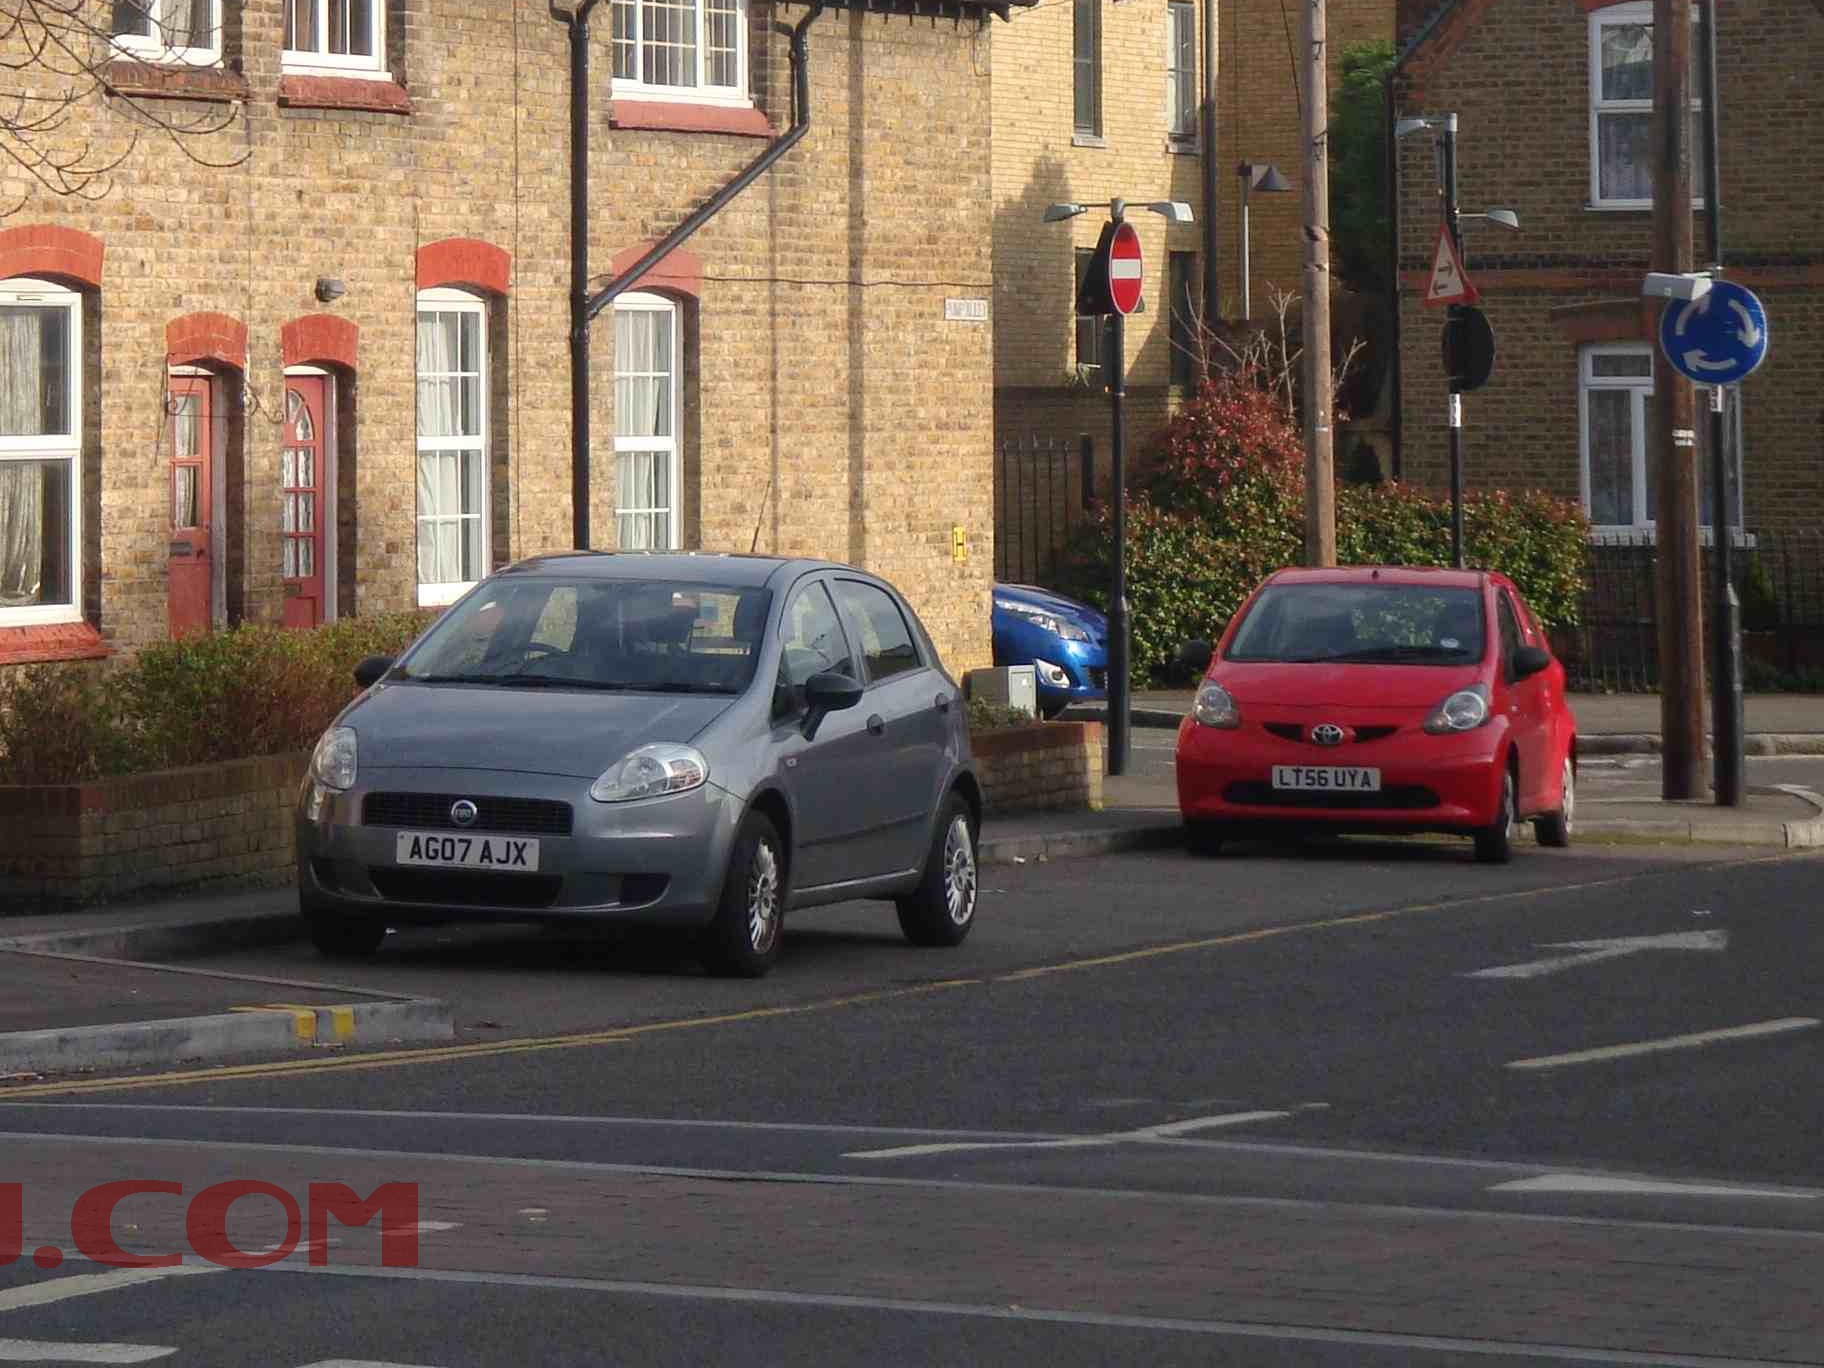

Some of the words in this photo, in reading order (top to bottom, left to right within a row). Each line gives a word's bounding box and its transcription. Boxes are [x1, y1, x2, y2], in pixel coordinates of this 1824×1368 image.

[1279, 768, 1329, 786] LT56
[1334, 770, 1372, 788] UYA
[409, 836, 472, 862] AG07
[479, 840, 527, 866] AJX
